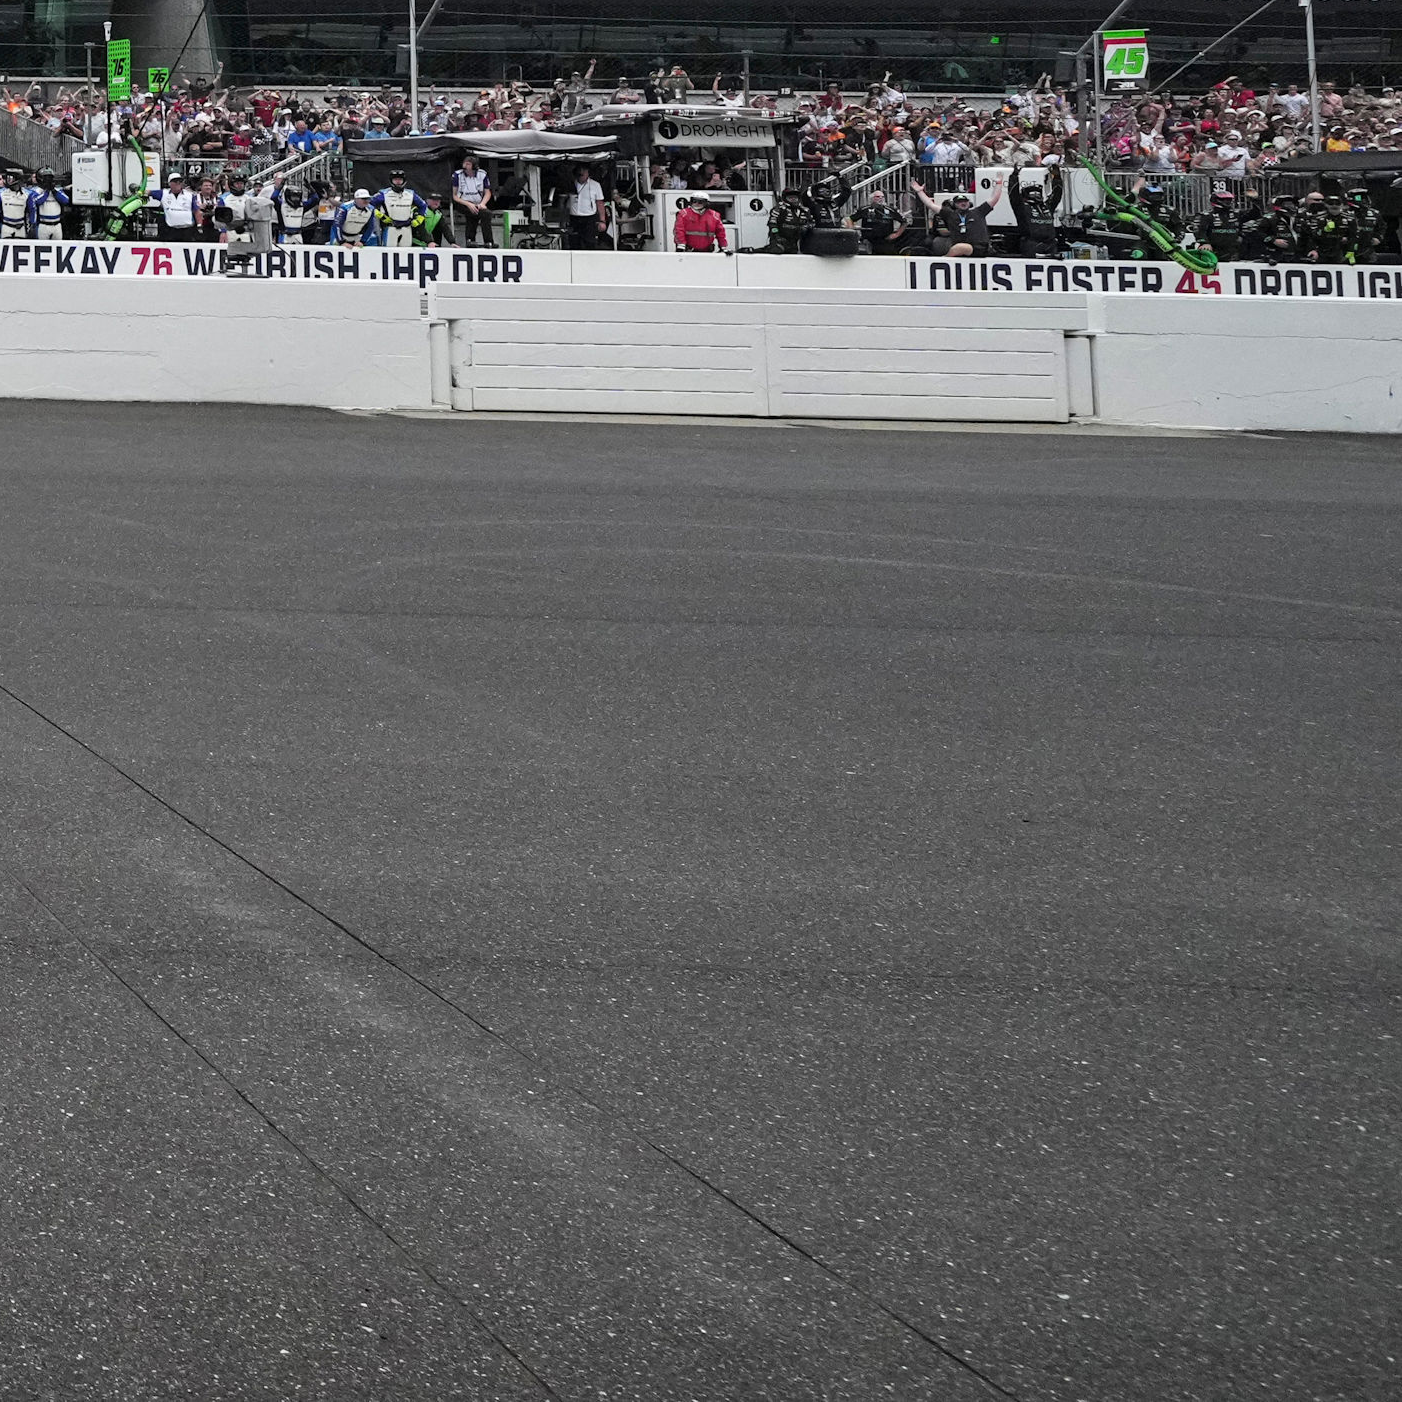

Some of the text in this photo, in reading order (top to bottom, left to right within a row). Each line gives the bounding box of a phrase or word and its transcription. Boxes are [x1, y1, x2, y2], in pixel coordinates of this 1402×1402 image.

[112, 57, 127, 77] 76
[1106, 47, 1146, 76] 45
[150, 70, 167, 84] 76
[188, 164, 202, 174] 42
[1212, 180, 1226, 192] 39
[131, 247, 173, 276] 76
[1024, 264, 1163, 293] FOSTER
[1175, 269, 1222, 295] 45
